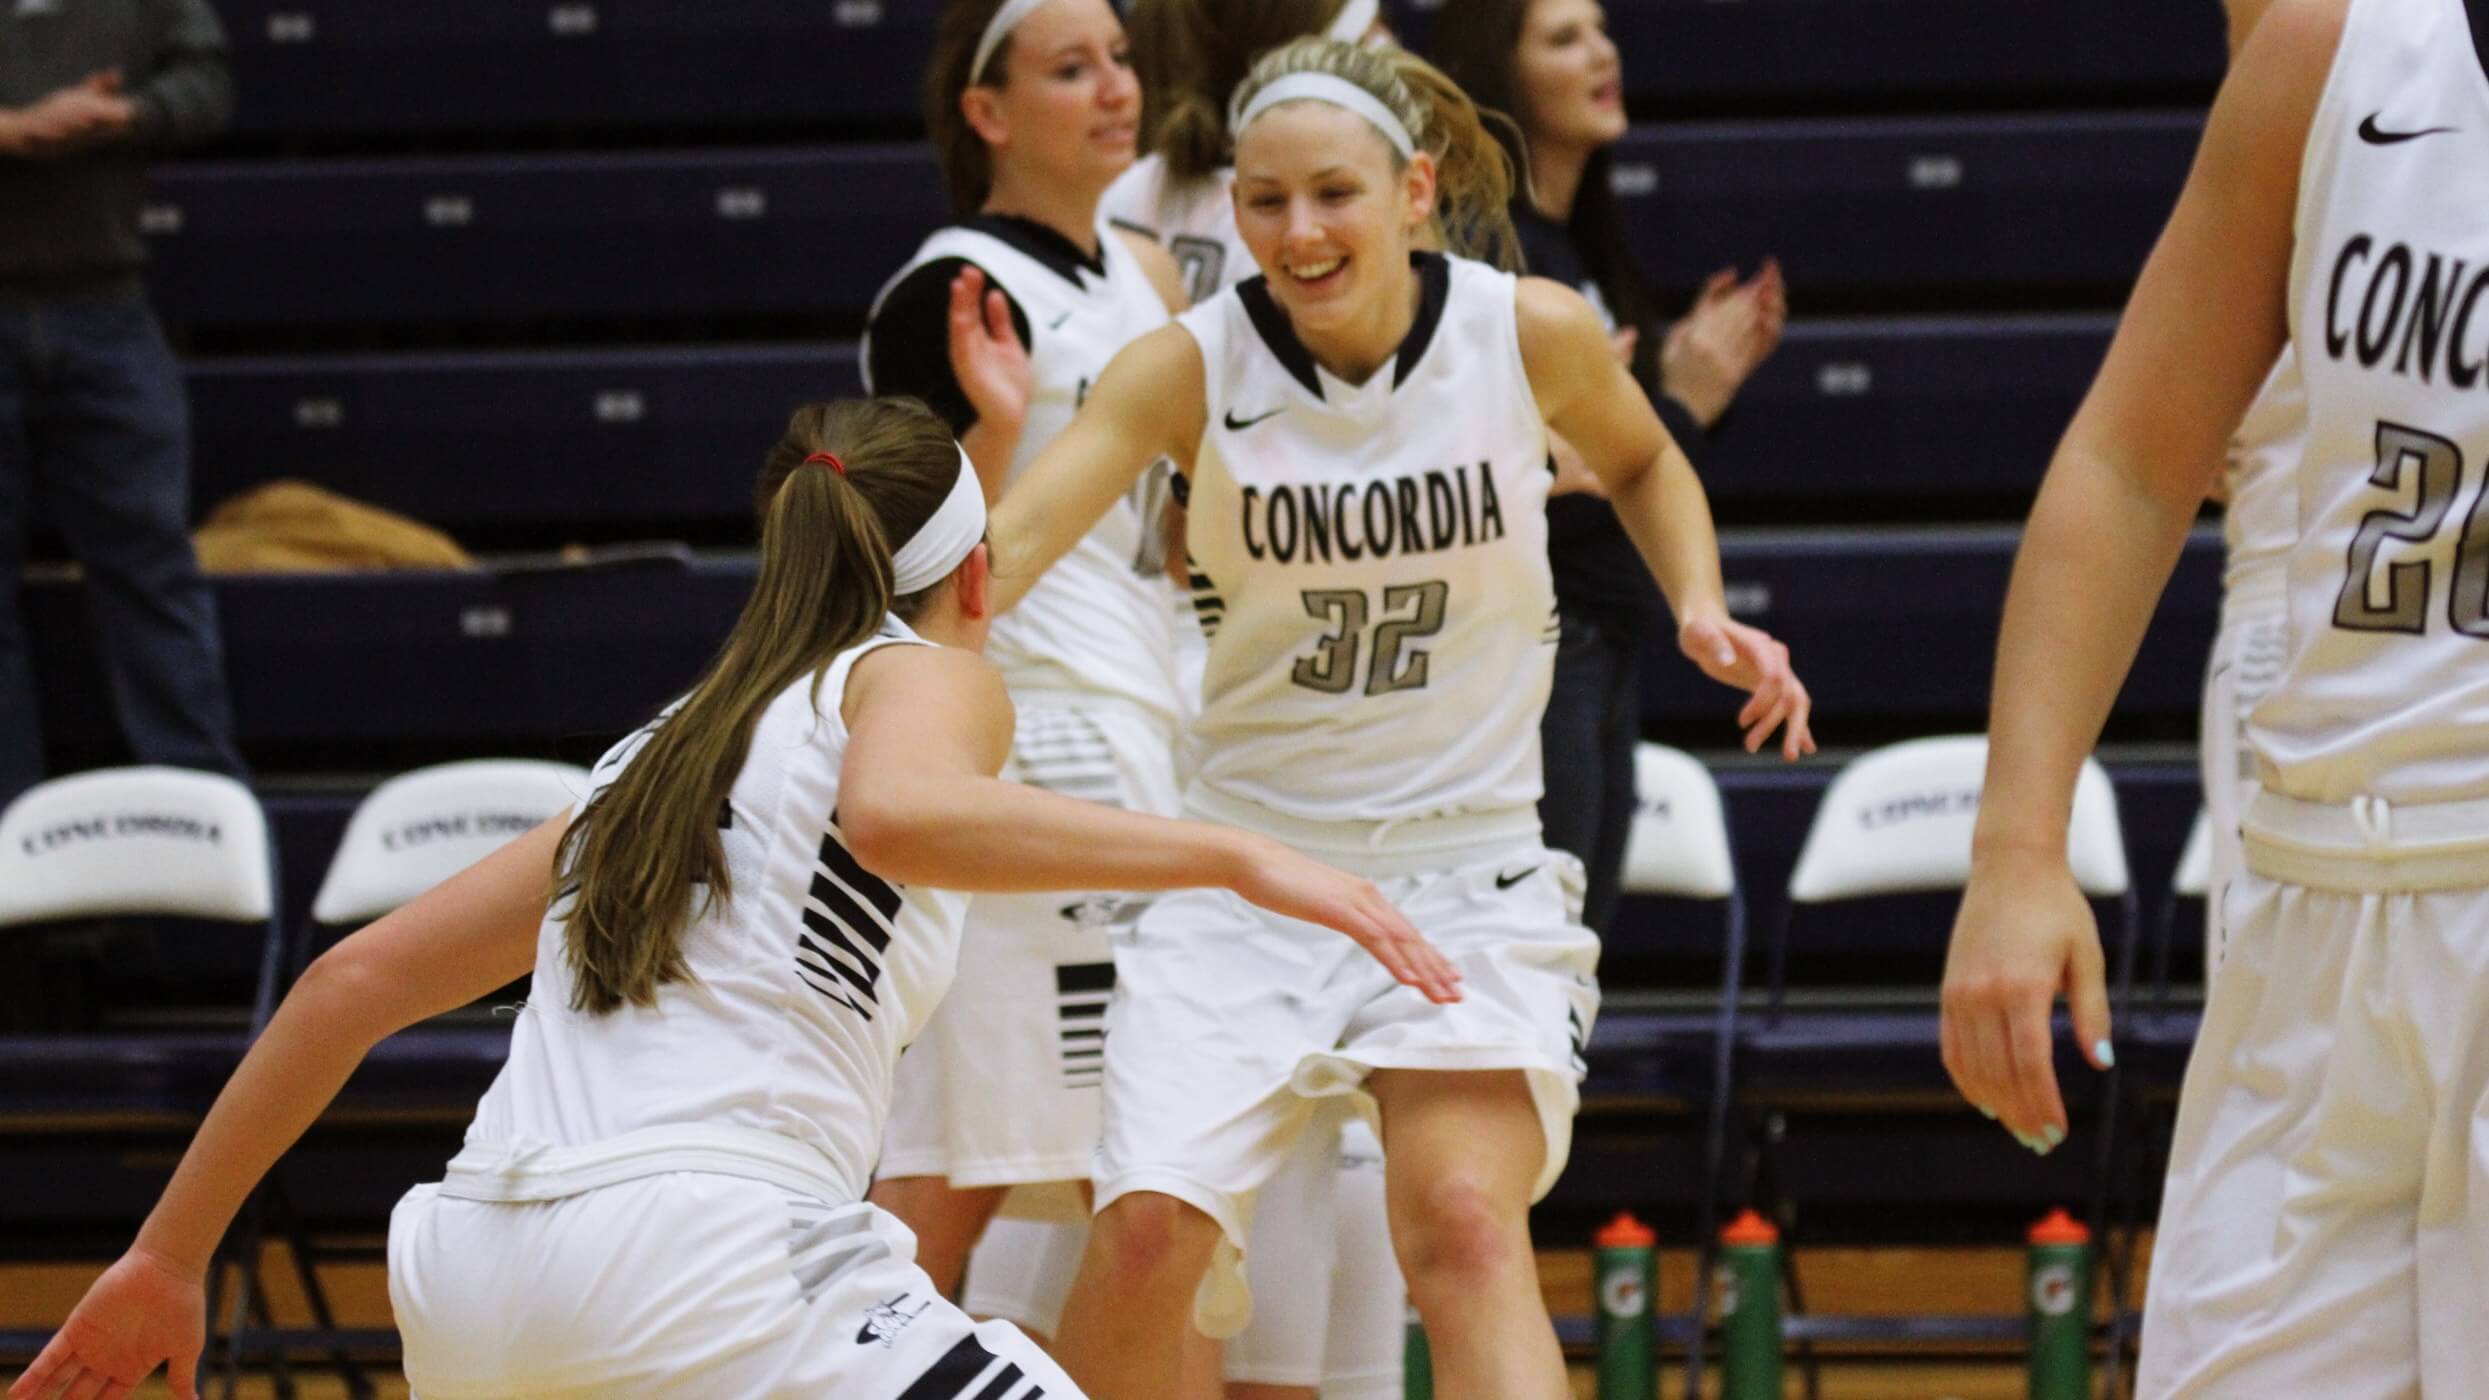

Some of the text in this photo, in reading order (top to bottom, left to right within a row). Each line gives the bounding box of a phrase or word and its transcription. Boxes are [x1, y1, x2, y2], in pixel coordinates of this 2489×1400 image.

[2325, 233, 2489, 389] CONC
[1242, 460, 1505, 565] CONCORDIA
[1291, 580, 1449, 697] 32
